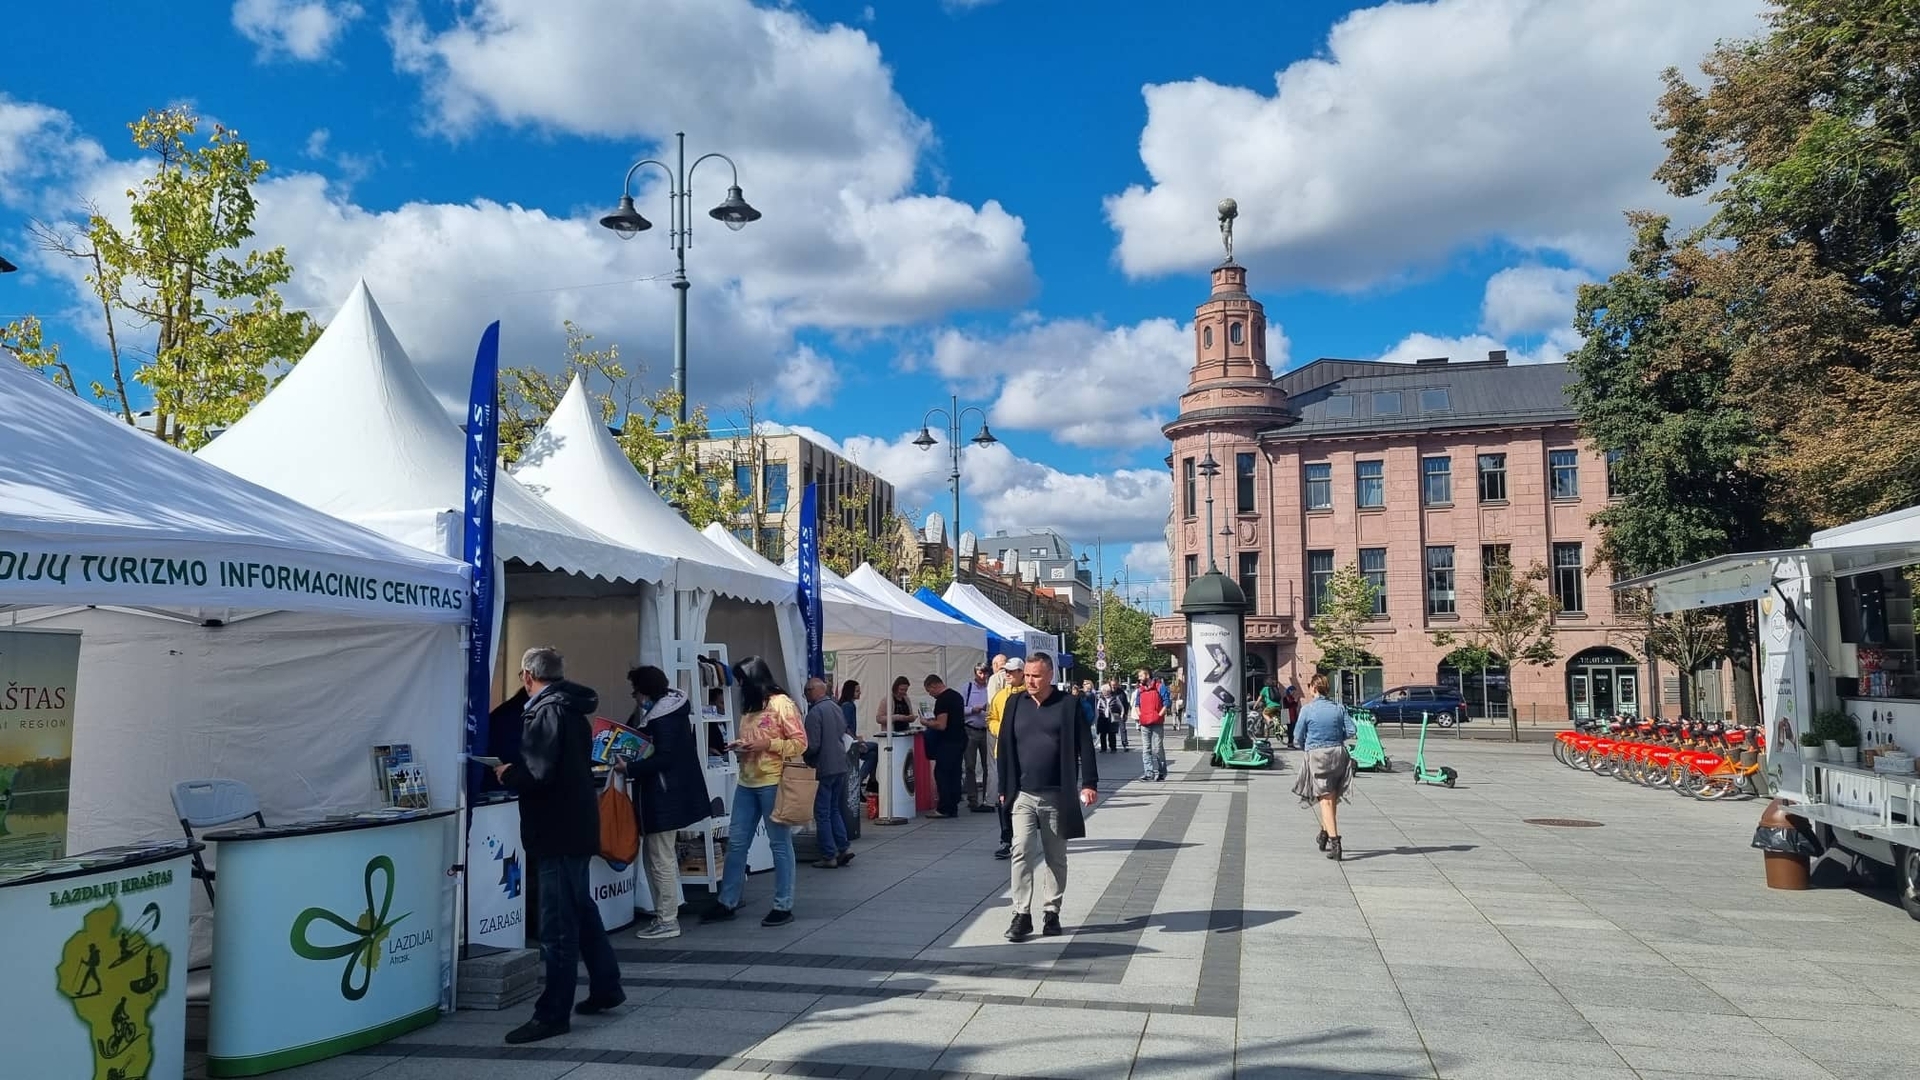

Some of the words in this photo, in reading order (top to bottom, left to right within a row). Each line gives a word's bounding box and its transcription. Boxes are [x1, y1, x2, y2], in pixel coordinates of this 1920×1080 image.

[0, 551, 71, 585] DIJŲ
[81, 555, 207, 586] TURIZMO
[220, 561, 377, 601] INFORMACINIS
[383, 581, 462, 609] CENTRAS
[0, 681, 66, 710] ŠTAS
[20, 719, 66, 728] REGION
[49, 881, 118, 906] LAZDIJŲ
[121, 870, 174, 893] KRAŠTAS
[595, 878, 635, 901] IGNALIN
[480, 907, 522, 934] ZARASAI
[389, 929, 433, 954] LAZDIJAI
